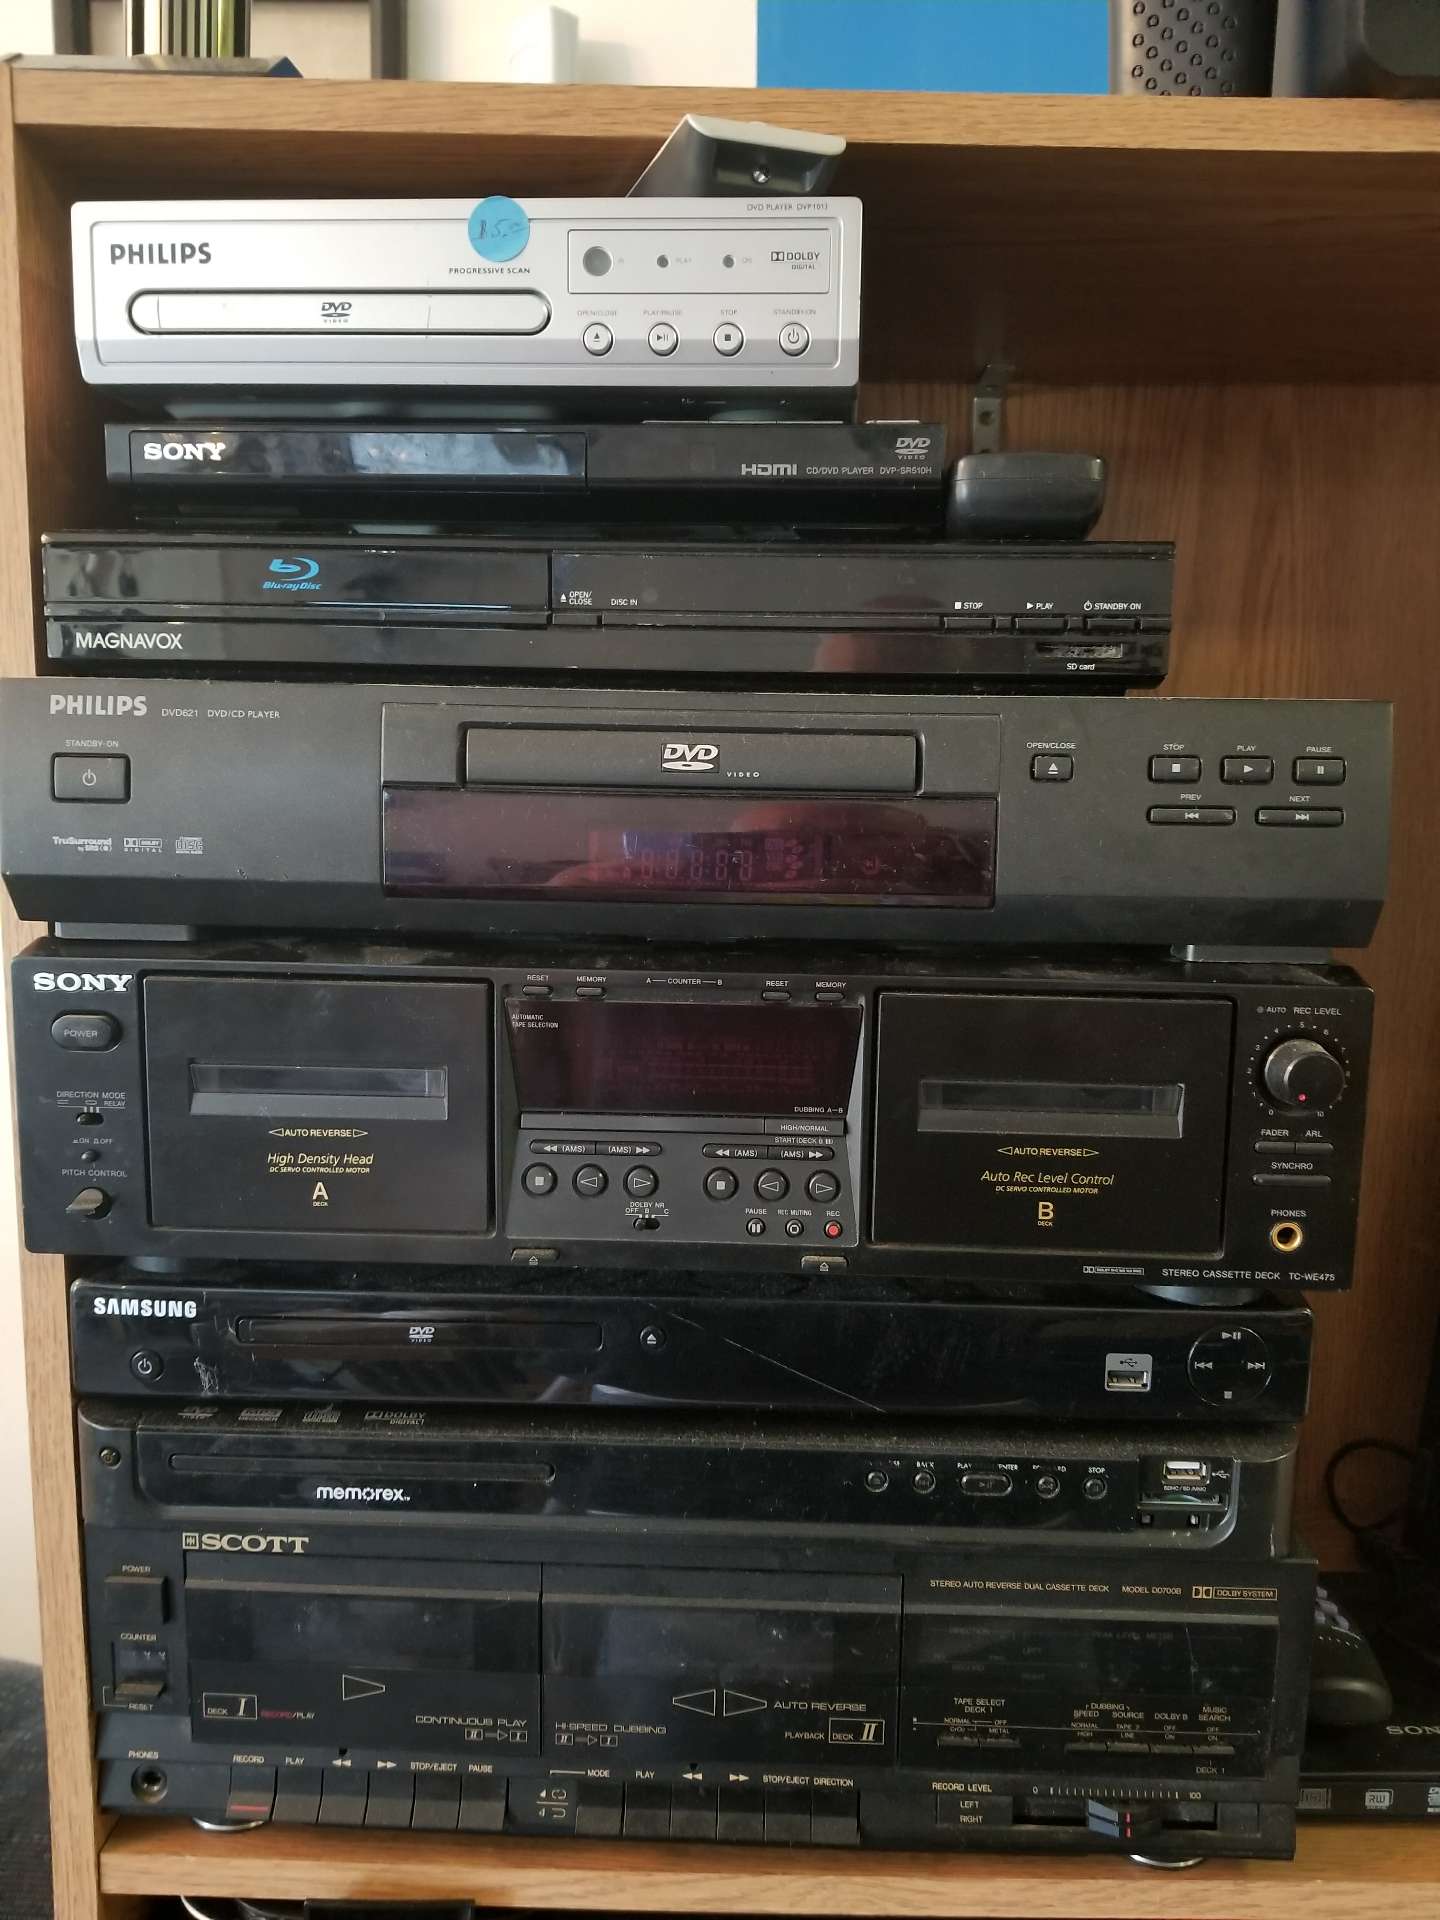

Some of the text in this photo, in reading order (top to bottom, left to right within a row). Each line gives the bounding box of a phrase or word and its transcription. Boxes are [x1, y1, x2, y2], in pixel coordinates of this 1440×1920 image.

[747, 203, 764, 211] DVD
[110, 242, 212, 264] PHILIPS
[786, 252, 820, 260] DOLBY
[321, 302, 352, 312] DVD
[895, 438, 931, 448] DVD
[143, 442, 226, 461] SONY
[741, 464, 798, 476] HDMI
[806, 466, 932, 476] CD/DVD PLAYER DVP-SR510H
[569, 590, 592, 598] OPEN/
[75, 632, 183, 650] MAGNAVOX
[50, 694, 148, 716] PHILIPS
[161, 708, 280, 719] DVD621 DVD/CD PLAYER
[663, 744, 719, 762] DVD
[33, 972, 132, 992] SONY
[64, 1029, 98, 1038] POWER
[284, 1129, 308, 1137] AUTO
[1261, 1129, 1289, 1137] FADER
[1040, 1148, 1082, 1156] REVERSE
[267, 1153, 374, 1166] High Density Head
[88, 1170, 128, 1178] CONTROL
[981, 1170, 1115, 1185] Auto Rec Level Control
[312, 1182, 329, 1200] A
[1038, 1201, 1054, 1220] B
[1271, 1209, 1307, 1217] PHONES
[1162, 1268, 1335, 1282] STEREO CASSETTE DECK TC-WE475
[94, 1297, 197, 1318] SAMSUNG
[409, 1326, 435, 1335] DVD
[202, 1533, 309, 1554] SCOTT
[121, 1633, 157, 1641] COUNTER
[773, 1701, 867, 1712] AUTO REVERSE
[976, 1698, 1005, 1706] SELECT
[207, 1707, 228, 1716] DECK
[261, 1711, 315, 1719] RECORD/PLAY
[415, 1716, 527, 1727] CONTINUOUS PLAY
[555, 1722, 667, 1735] HI-SPEED DUBBING
[785, 1731, 825, 1740] PLAYBACK
[832, 1733, 854, 1741] DECK
[128, 1750, 158, 1760] PHONES
[233, 1755, 264, 1764] RECORD
[285, 1757, 304, 1765] PLAY
[410, 1762, 457, 1772] STOP/EJECT
[468, 1764, 492, 1773] PAUSE
[763, 1775, 809, 1785] STOP/EJECT
[814, 1778, 854, 1787] DIRECTION
[932, 1782, 993, 1793] RECORD LEVEL
